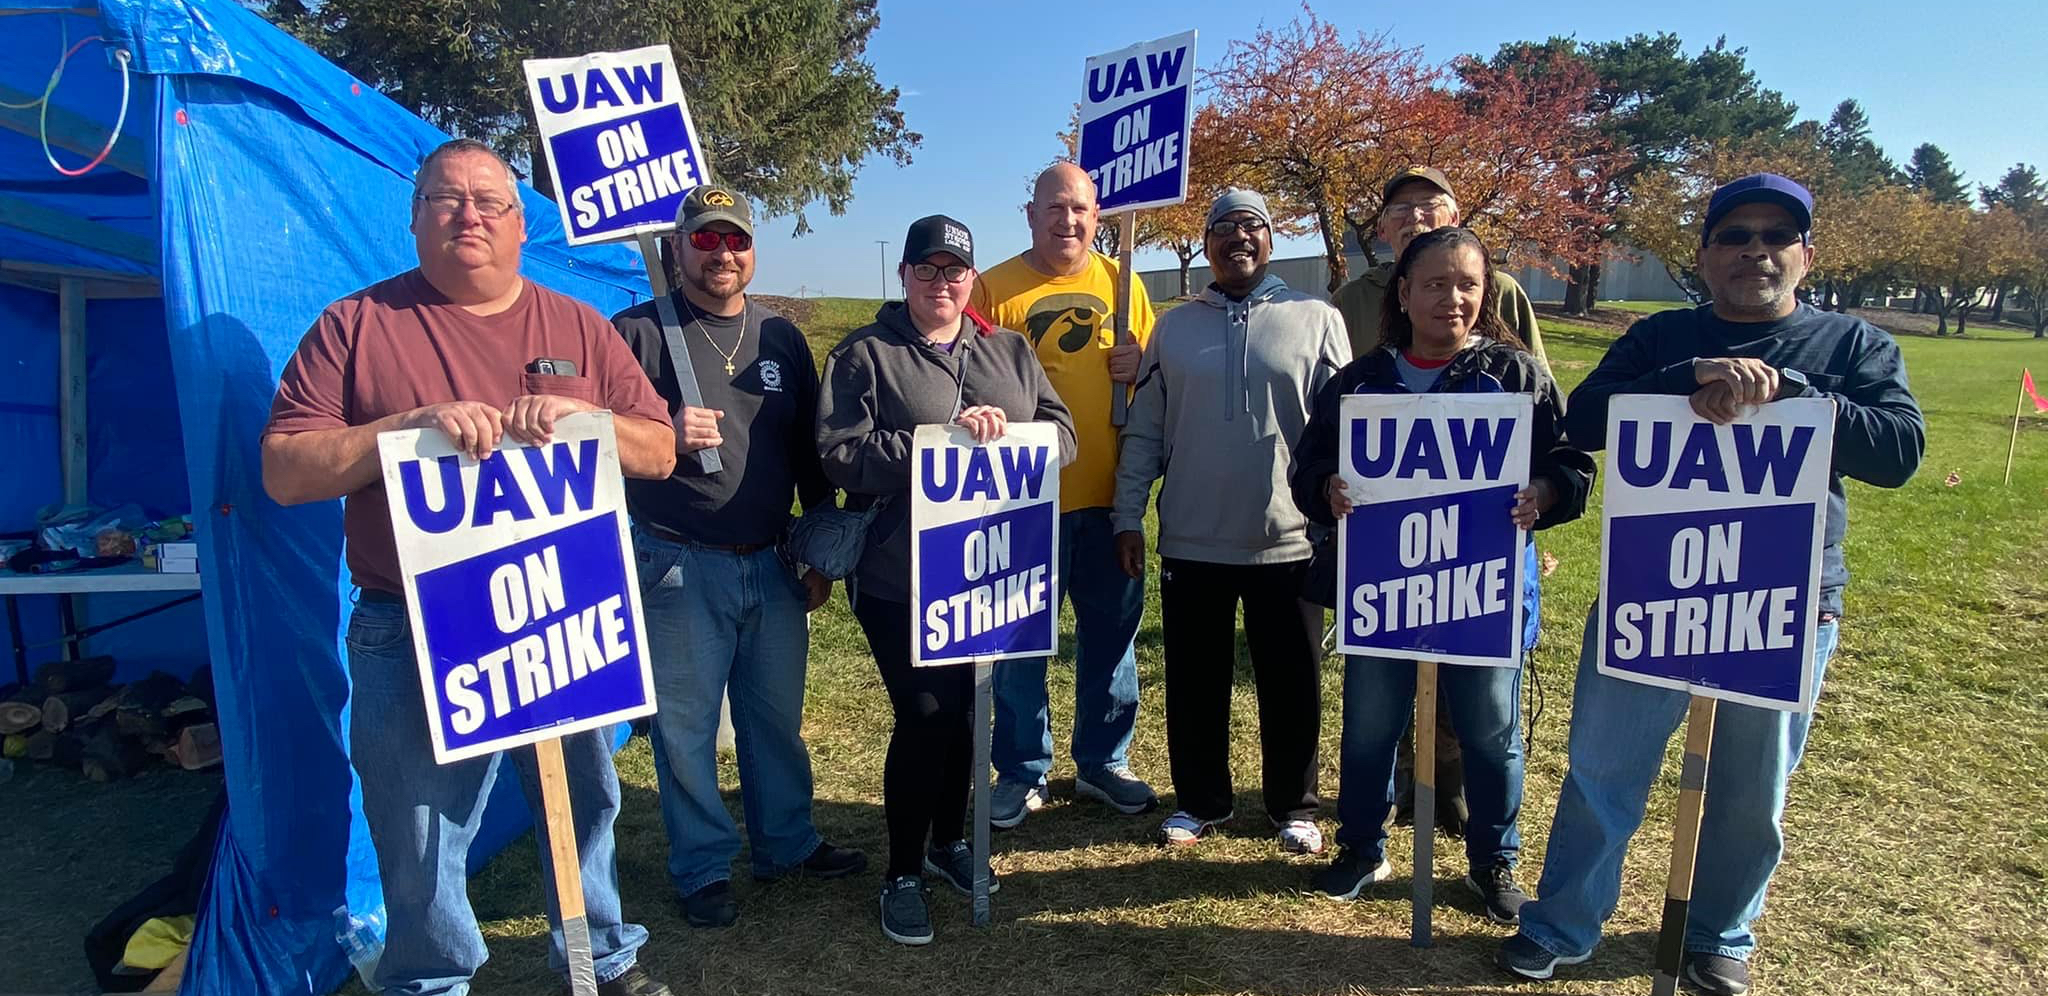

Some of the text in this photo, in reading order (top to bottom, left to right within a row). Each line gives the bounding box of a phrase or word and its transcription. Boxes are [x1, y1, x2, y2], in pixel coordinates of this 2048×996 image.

[537, 62, 663, 114] UAW
[1088, 46, 1187, 103] UAW
[597, 120, 649, 169] ON
[1113, 104, 1151, 153] ON
[571, 149, 698, 229] STRIKE
[921, 446, 1049, 503] UAW
[1351, 418, 1517, 480] UAW
[1617, 420, 1816, 497] UAW
[398, 438, 600, 534] UAW
[964, 520, 1011, 582] ON
[1400, 503, 1459, 569] ON
[1669, 521, 1742, 589] ON
[489, 545, 566, 634] ON
[926, 563, 1047, 652] STRIKE
[1352, 557, 1507, 637] STRIKE
[1614, 586, 1798, 660] STRIKE
[445, 593, 631, 735] STRIKE
